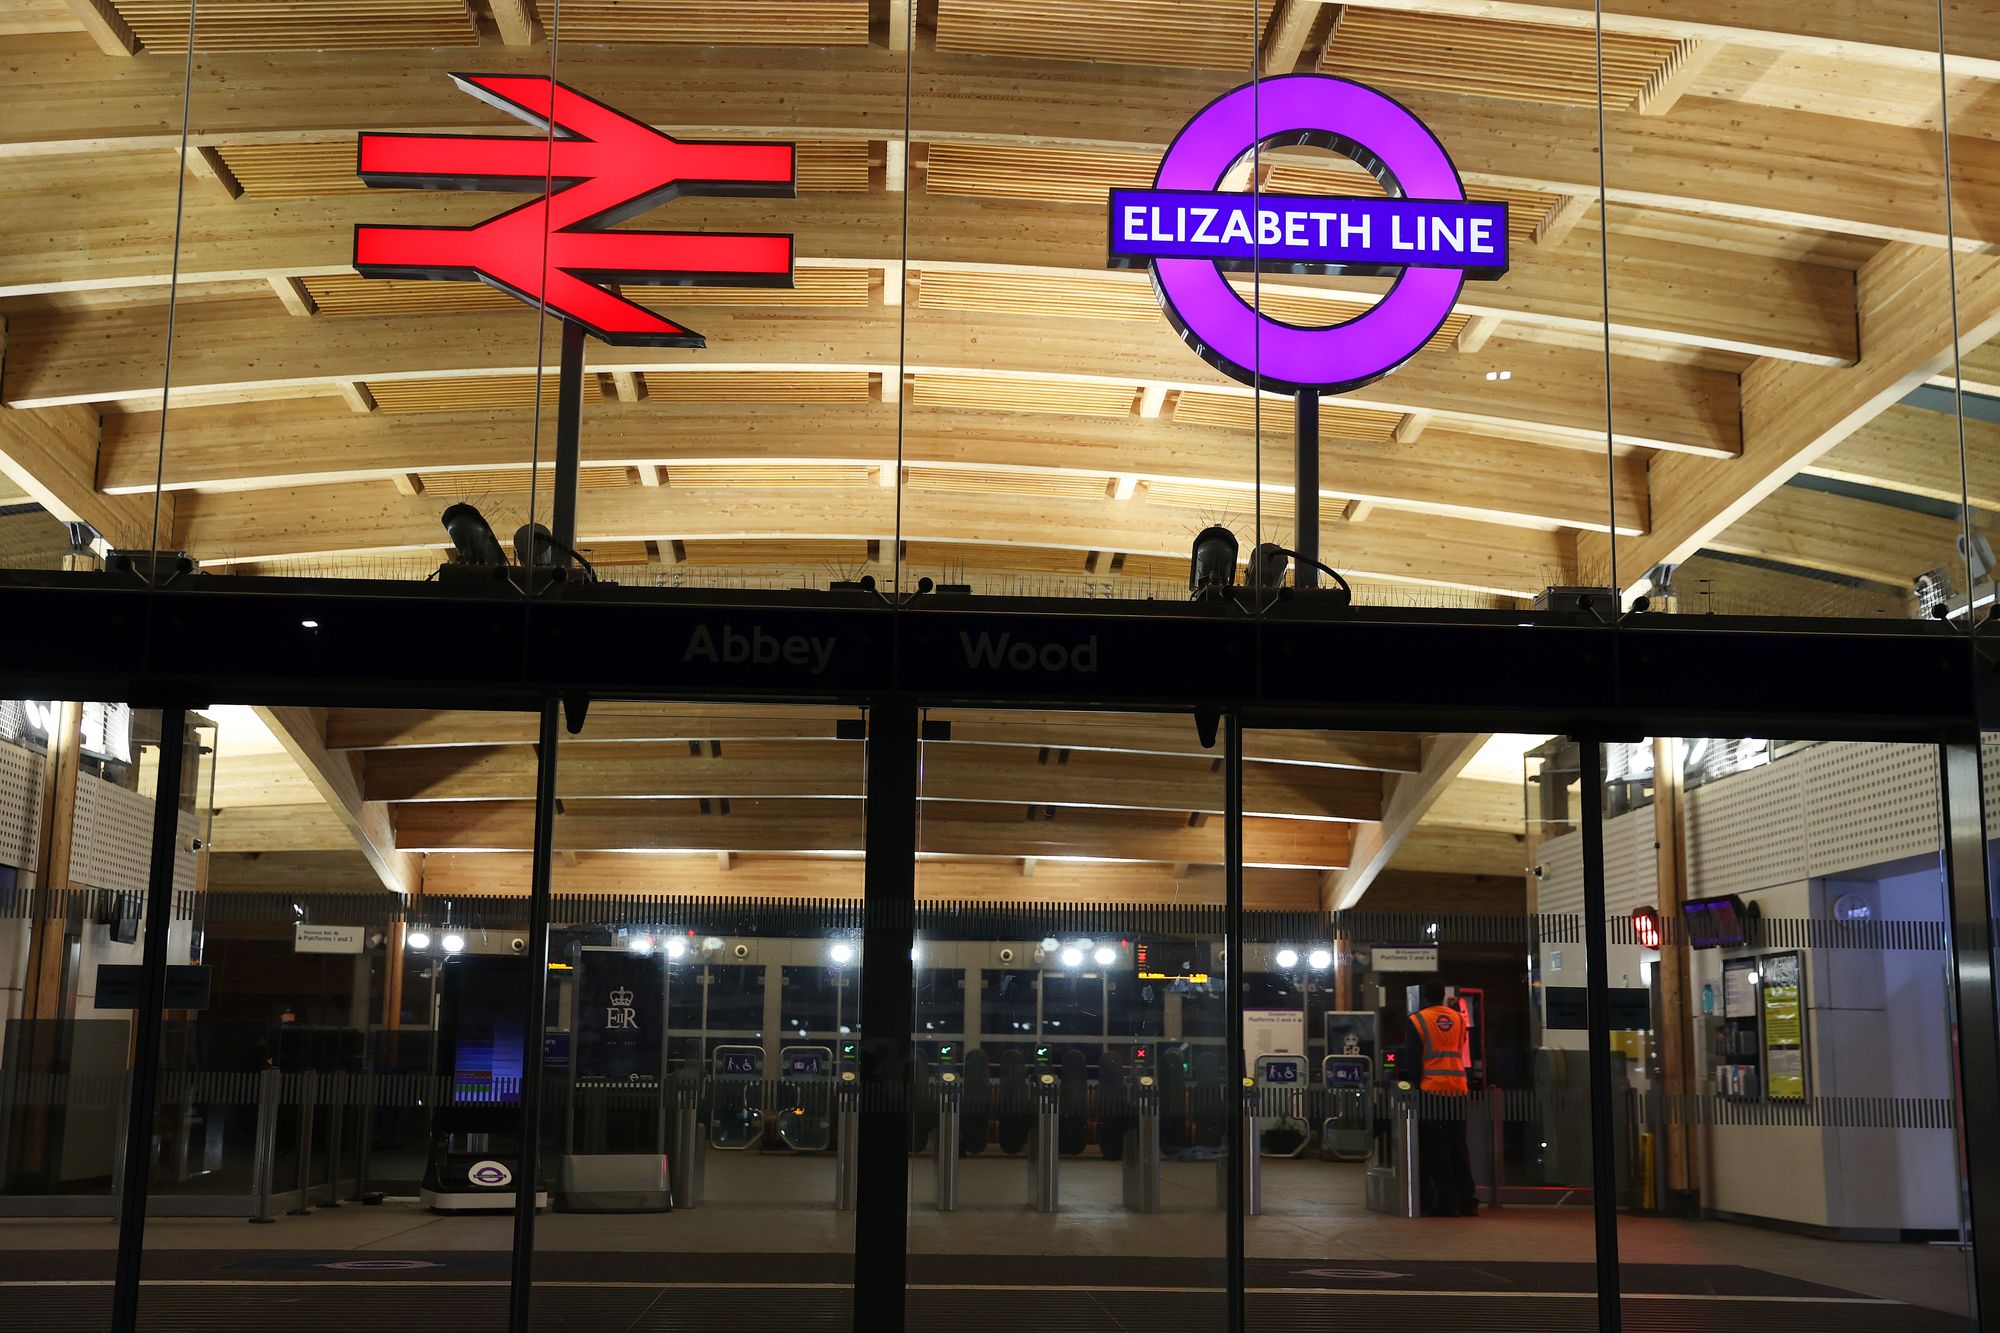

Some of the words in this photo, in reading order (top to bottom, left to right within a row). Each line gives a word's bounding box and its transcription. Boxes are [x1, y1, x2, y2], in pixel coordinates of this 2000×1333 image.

[1123, 205, 1371, 249] ELIZABETH
[1391, 215, 1494, 254] LINE
[680, 623, 838, 675] Abbey
[958, 631, 1099, 674] Wood
